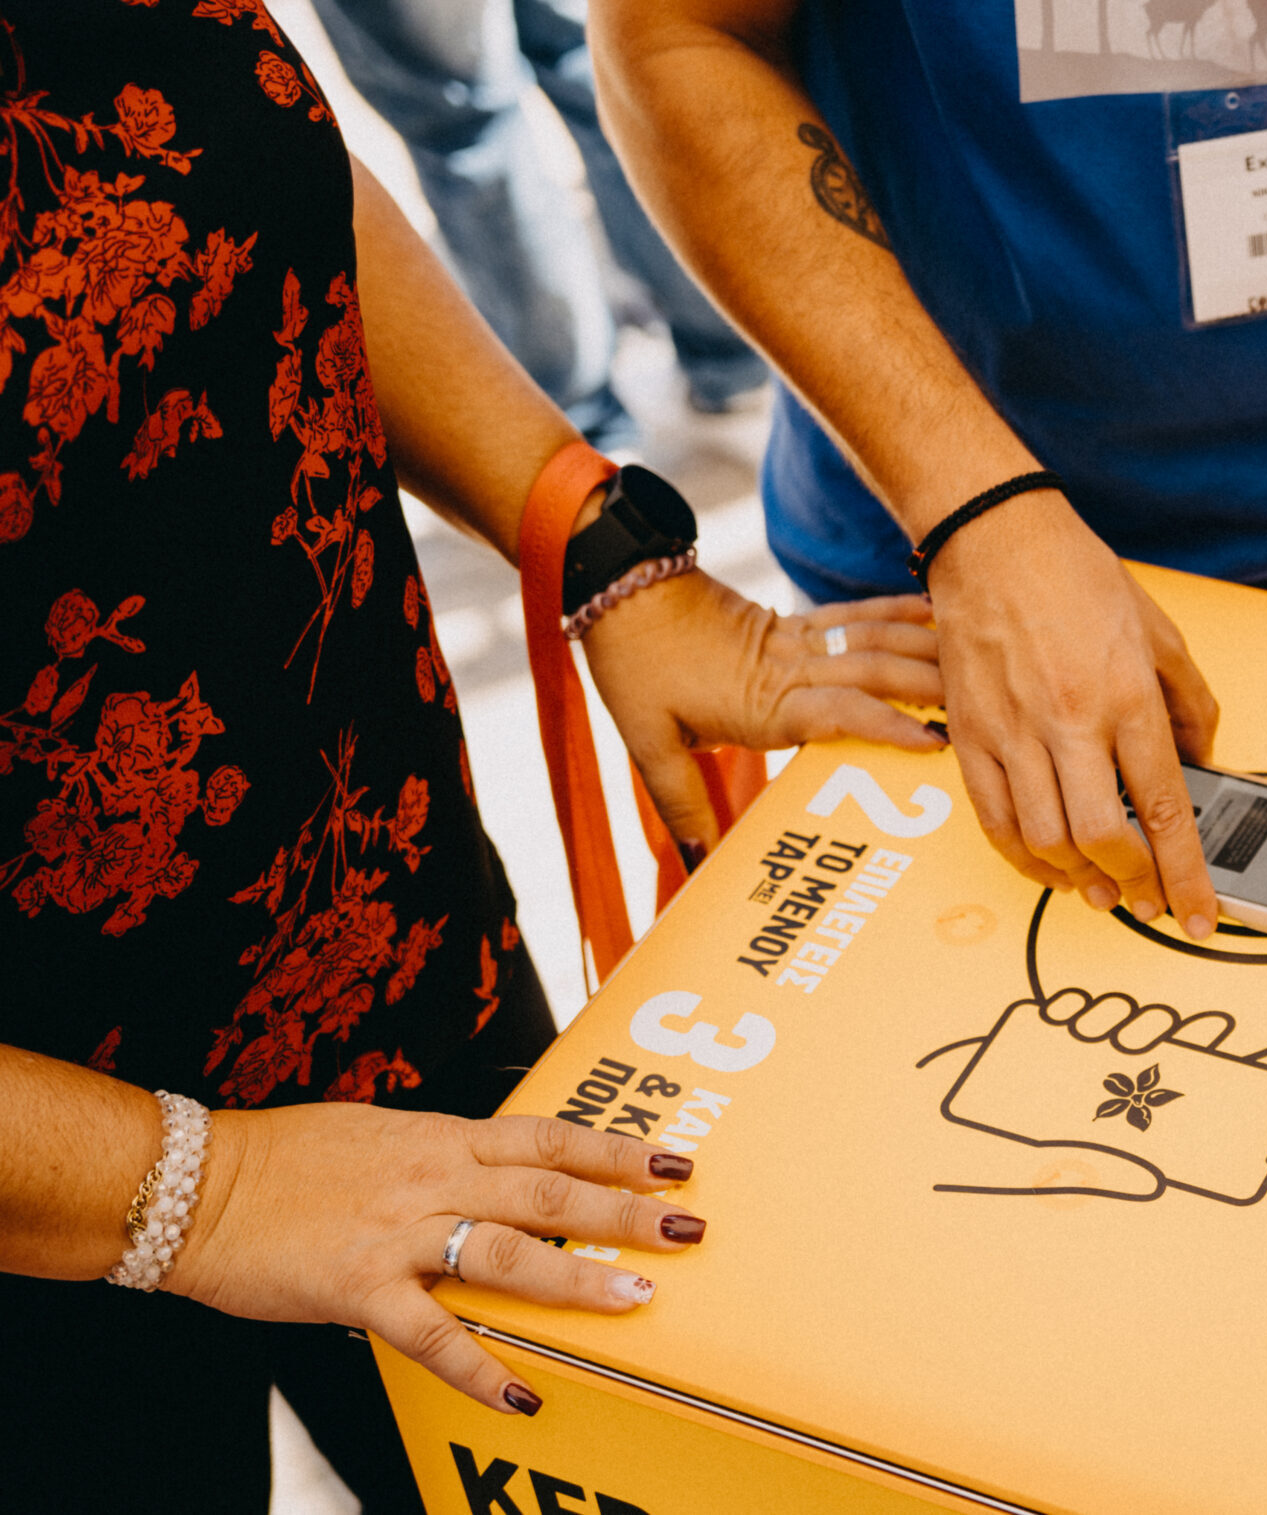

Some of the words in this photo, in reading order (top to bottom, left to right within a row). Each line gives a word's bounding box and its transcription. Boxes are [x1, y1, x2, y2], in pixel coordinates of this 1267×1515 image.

[805, 763, 953, 838] 2
[760, 831, 821, 882] TAP
[815, 840, 869, 873] ΤΟ
[737, 876, 837, 977] ΜΕΝΟΥ
[775, 848, 913, 994] ΕΠΙΛΕΓΕΙΣ
[629, 990, 776, 1072] 3
[634, 1073, 682, 1098] &
